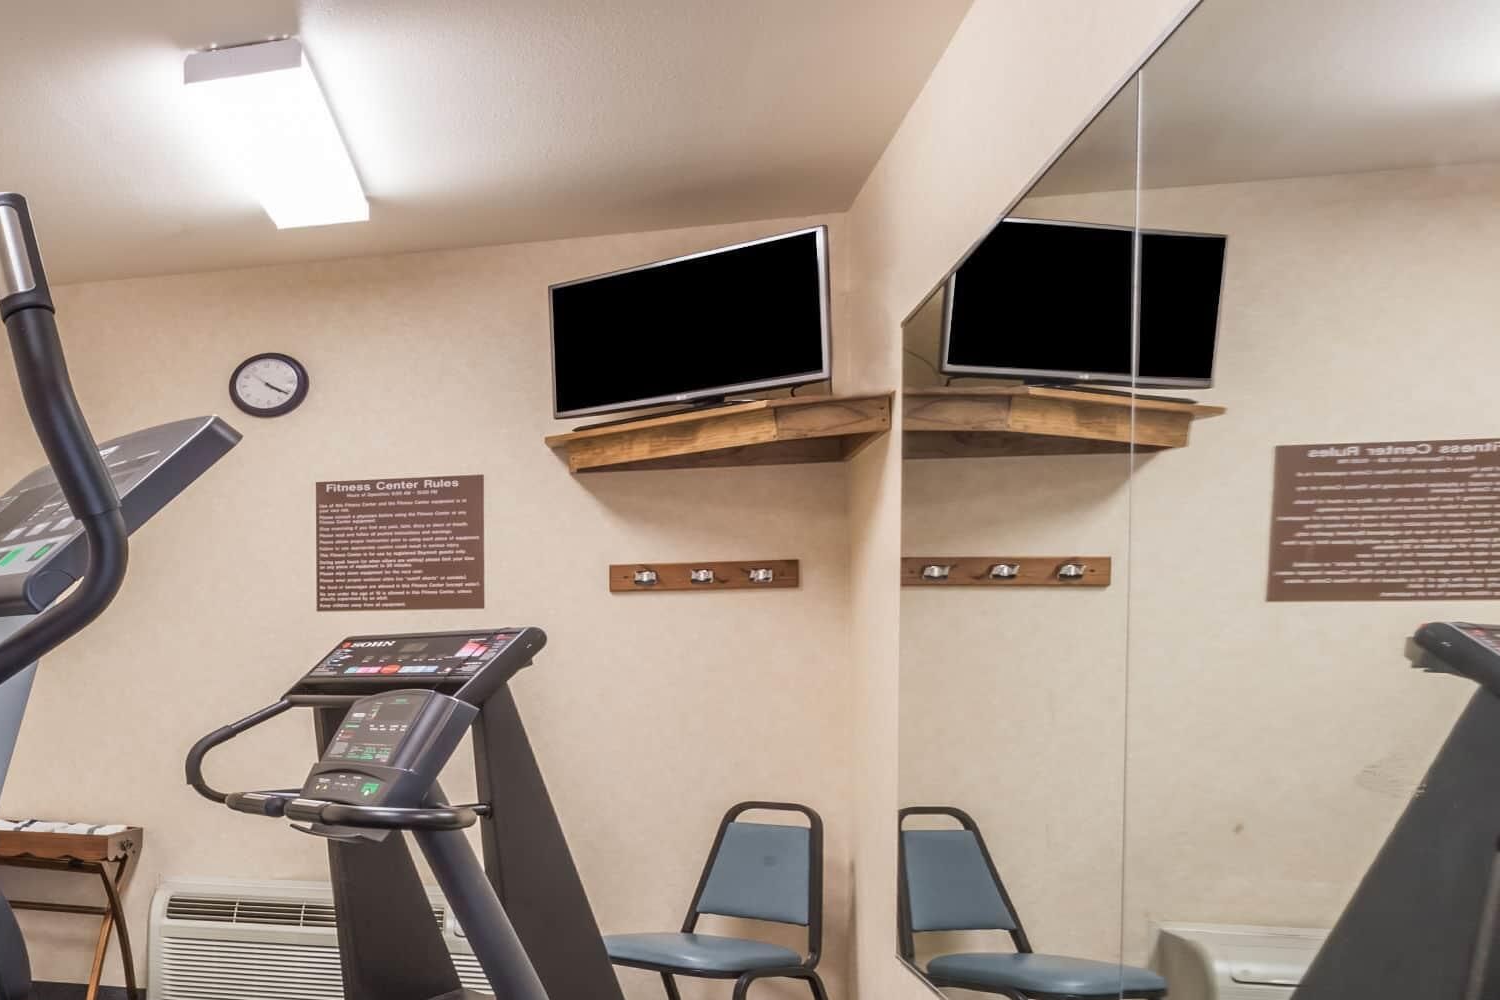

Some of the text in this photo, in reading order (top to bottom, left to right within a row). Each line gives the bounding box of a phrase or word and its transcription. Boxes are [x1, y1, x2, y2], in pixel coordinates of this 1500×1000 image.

[326, 479, 459, 493] Fitness Center Rules
